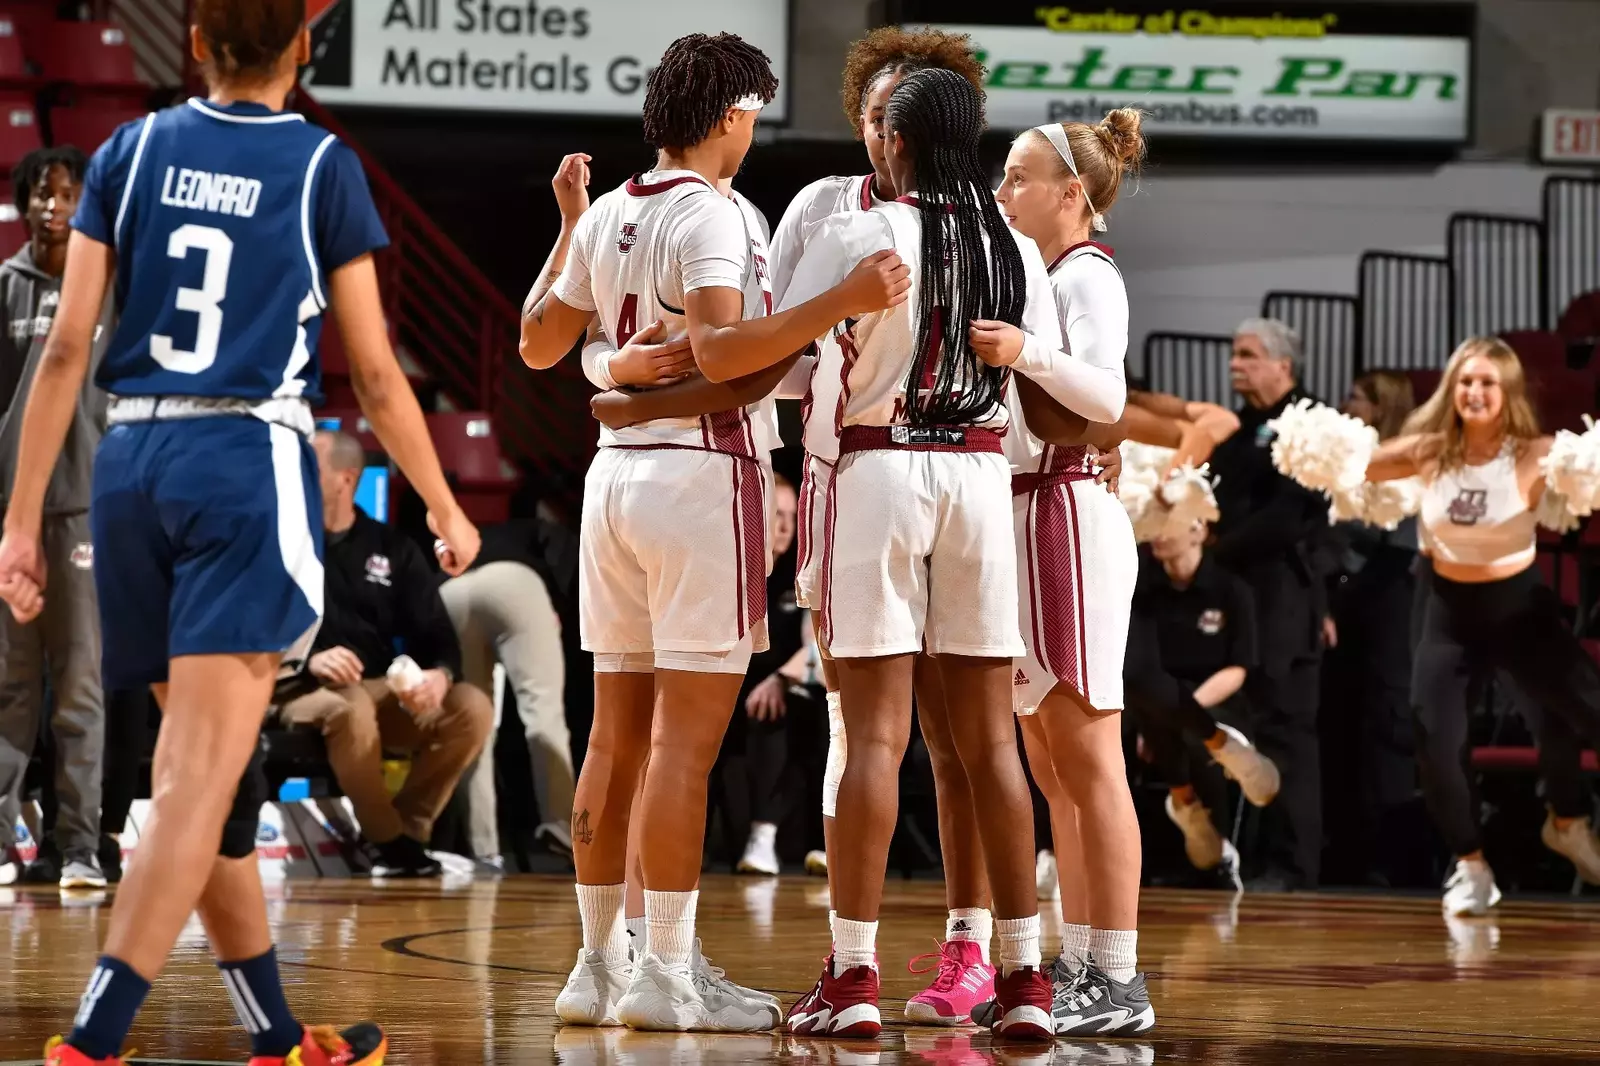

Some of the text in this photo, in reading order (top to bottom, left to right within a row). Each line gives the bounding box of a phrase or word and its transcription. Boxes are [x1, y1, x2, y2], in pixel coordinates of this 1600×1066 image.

[382, 0, 591, 38] All States
[1143, 10, 1175, 35] of
[380, 47, 591, 93] Materials
[975, 46, 1458, 100] eter Pan
[160, 165, 263, 218] LEONARD
[150, 223, 234, 374] 3
